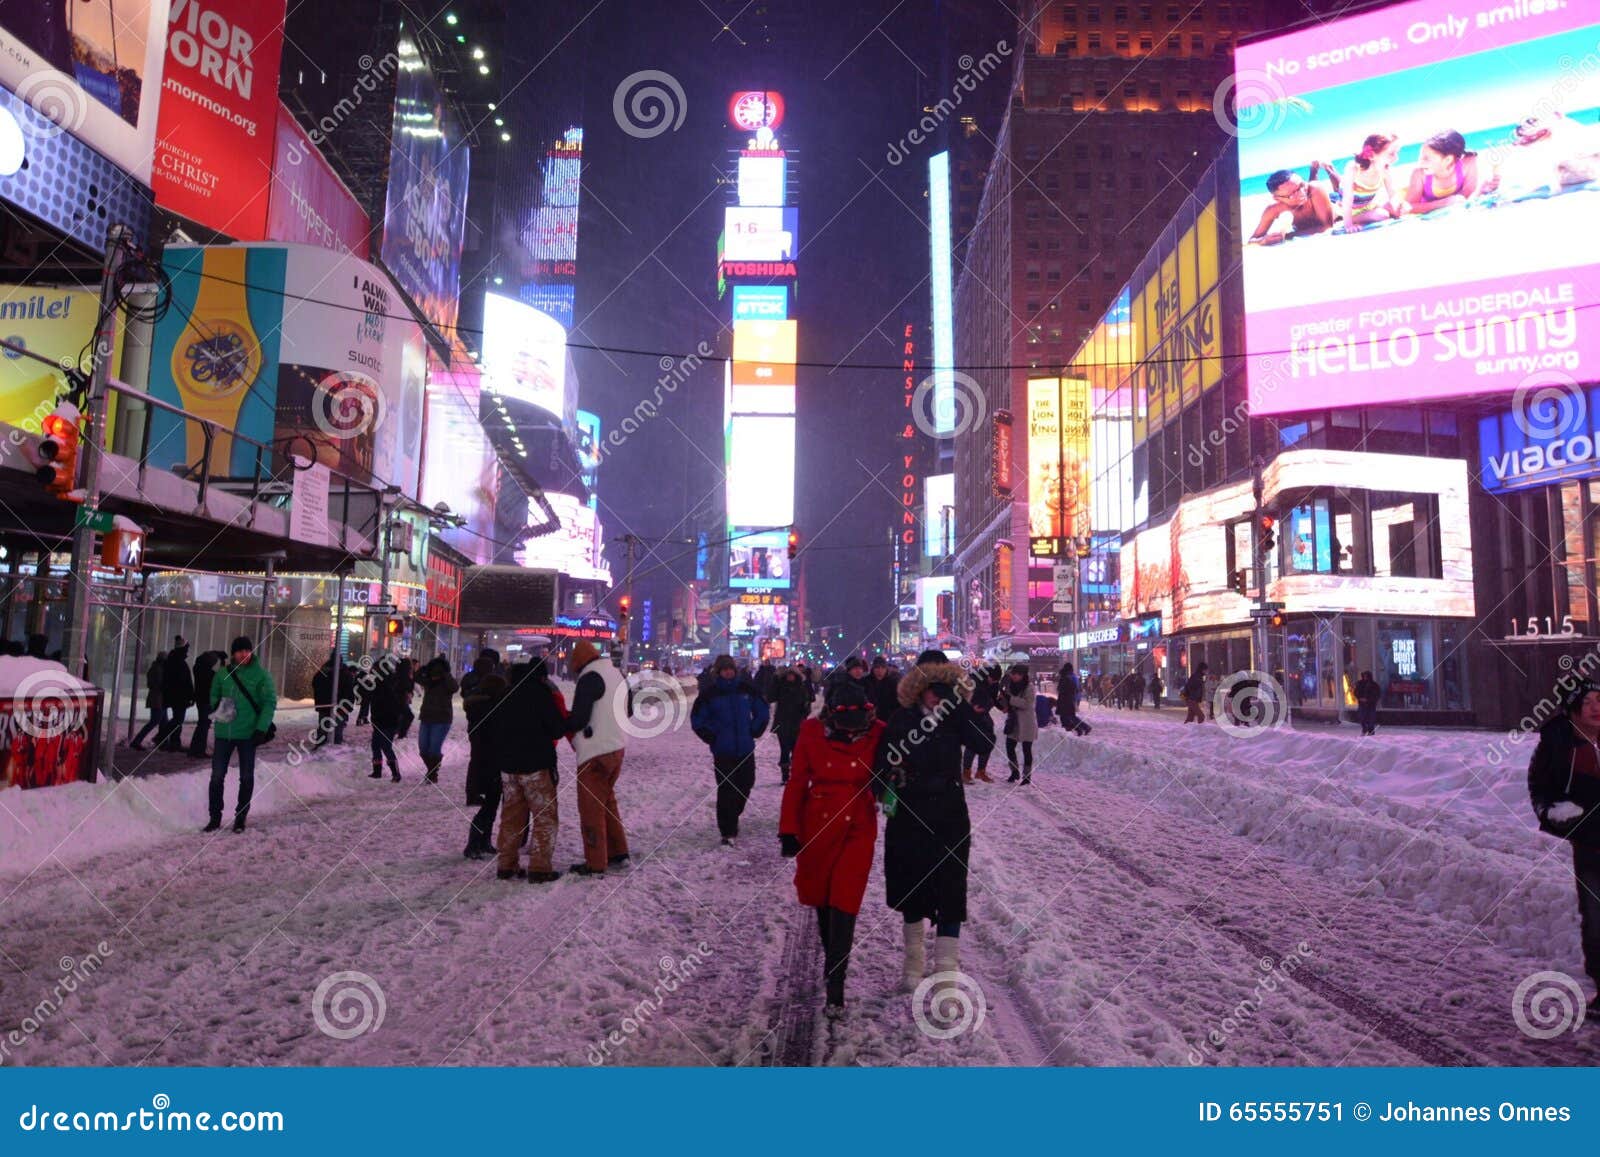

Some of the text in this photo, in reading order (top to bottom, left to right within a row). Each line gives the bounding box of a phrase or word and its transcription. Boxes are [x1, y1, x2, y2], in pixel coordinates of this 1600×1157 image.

[166, 30, 254, 101] ORN
[1265, 59, 1300, 80] No
[1306, 36, 1399, 72] scarves.
[1407, 15, 1469, 44] Only
[161, 77, 257, 137] .mormon.org
[161, 153, 219, 189] CHRIST
[353, 275, 359, 289] I
[724, 263, 797, 276] TOSHIBA
[1154, 279, 1179, 333] THE
[1290, 283, 1574, 340] greater FORT LAUDERDALE
[903, 324, 915, 408] ERNST
[1476, 351, 1579, 376] sunny.org
[1031, 423, 1057, 437] KING
[1032, 409, 1054, 421] LION
[1488, 434, 1600, 479] viaco
[85, 511, 94, 525] 7
[902, 455, 915, 544] YOUNG
[1510, 616, 1576, 638] 1515
